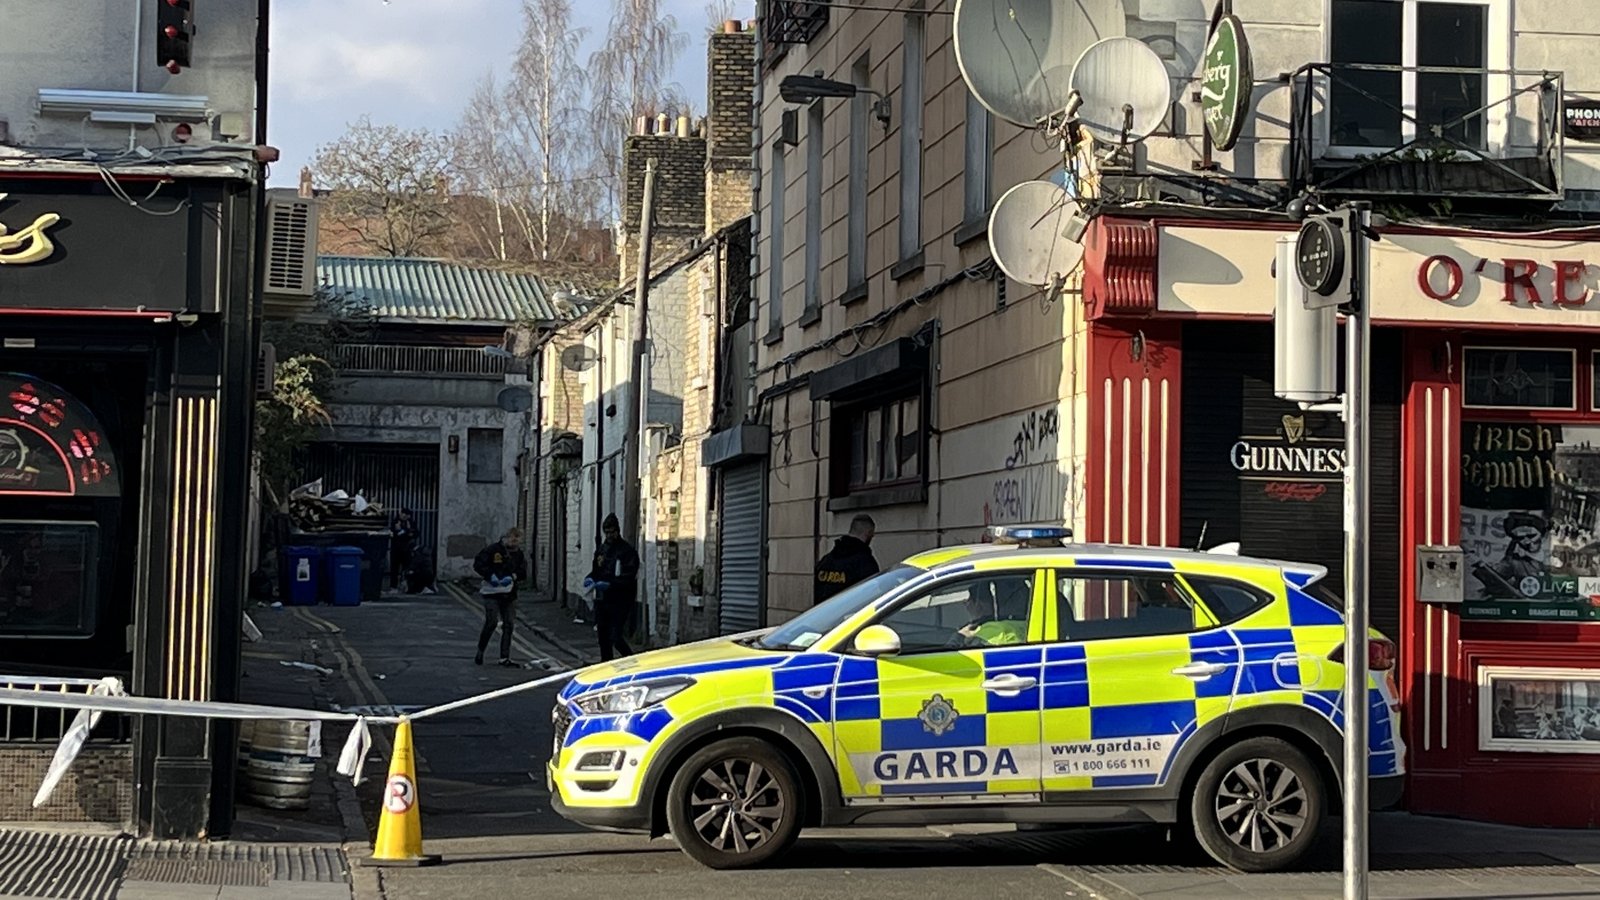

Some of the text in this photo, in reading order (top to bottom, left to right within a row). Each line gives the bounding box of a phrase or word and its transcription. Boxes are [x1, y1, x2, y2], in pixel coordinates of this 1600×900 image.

[1542, 580, 1600, 595] LIVE M
[1051, 738, 1161, 756] www.garda.ie
[873, 747, 1019, 781] GARDA
[1073, 758, 1151, 771] 1 800 666 111
